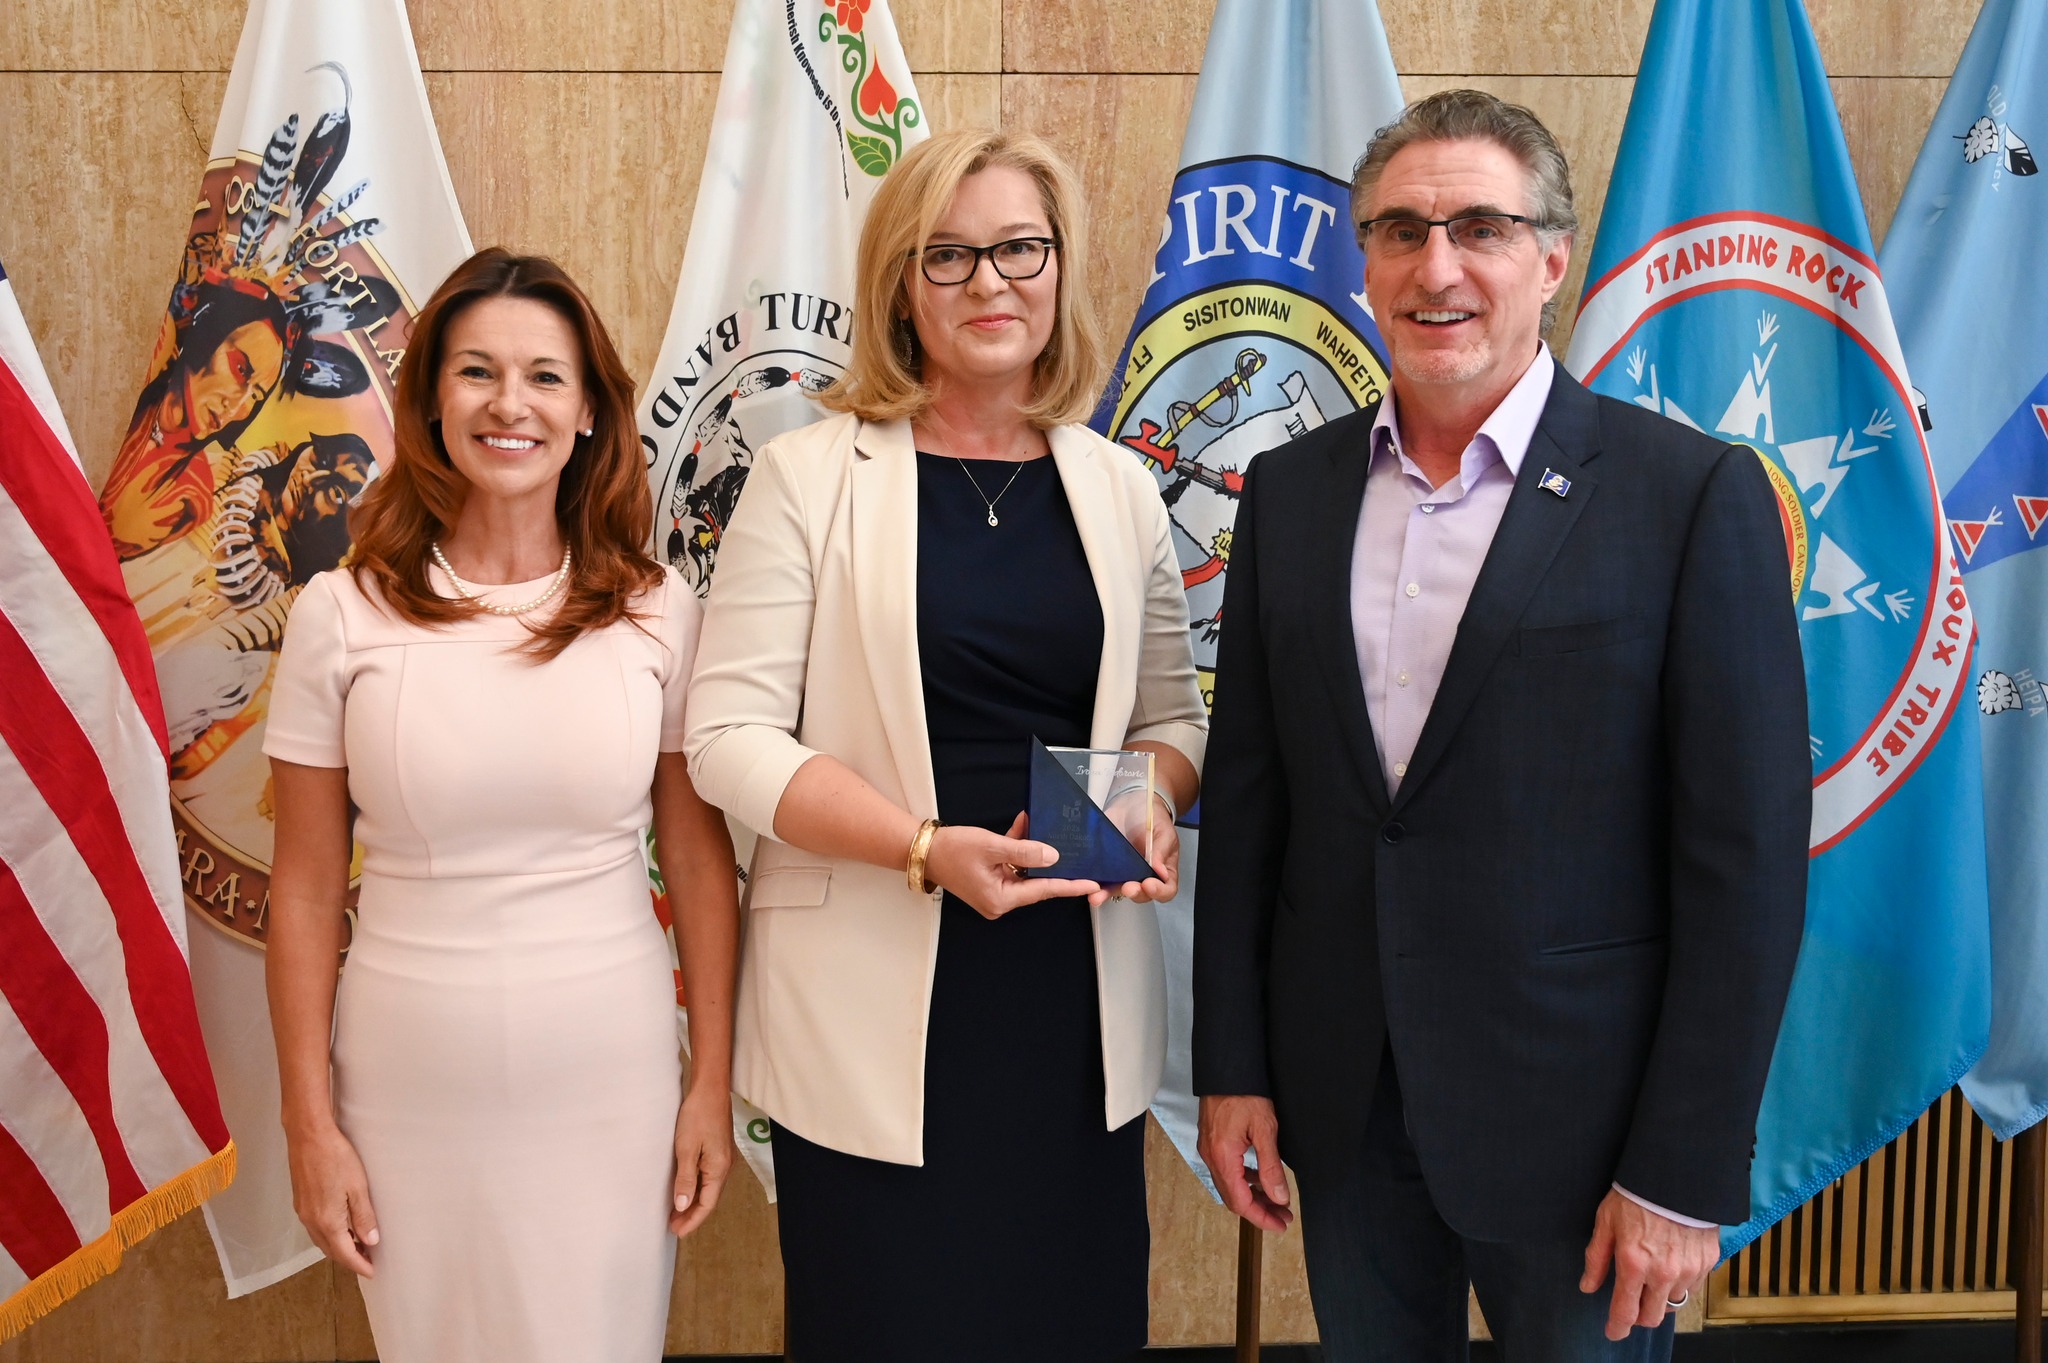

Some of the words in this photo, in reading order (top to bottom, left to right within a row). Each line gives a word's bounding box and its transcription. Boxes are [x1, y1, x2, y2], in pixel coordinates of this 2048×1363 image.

[822, 94, 833, 111] is
[829, 105, 839, 121] to
[289, 222, 378, 309] FORT
[1646, 233, 1778, 294] STANDING
[1786, 244, 1866, 309] ROCK
[1183, 296, 1292, 332] SISITONWAN
[651, 310, 742, 429] BAND
[1768, 466, 1788, 495] LONG
[1785, 493, 1805, 541] SOLDIER
[1866, 683, 1942, 777] TRIBE
[2014, 668, 2045, 718] HEIPA
